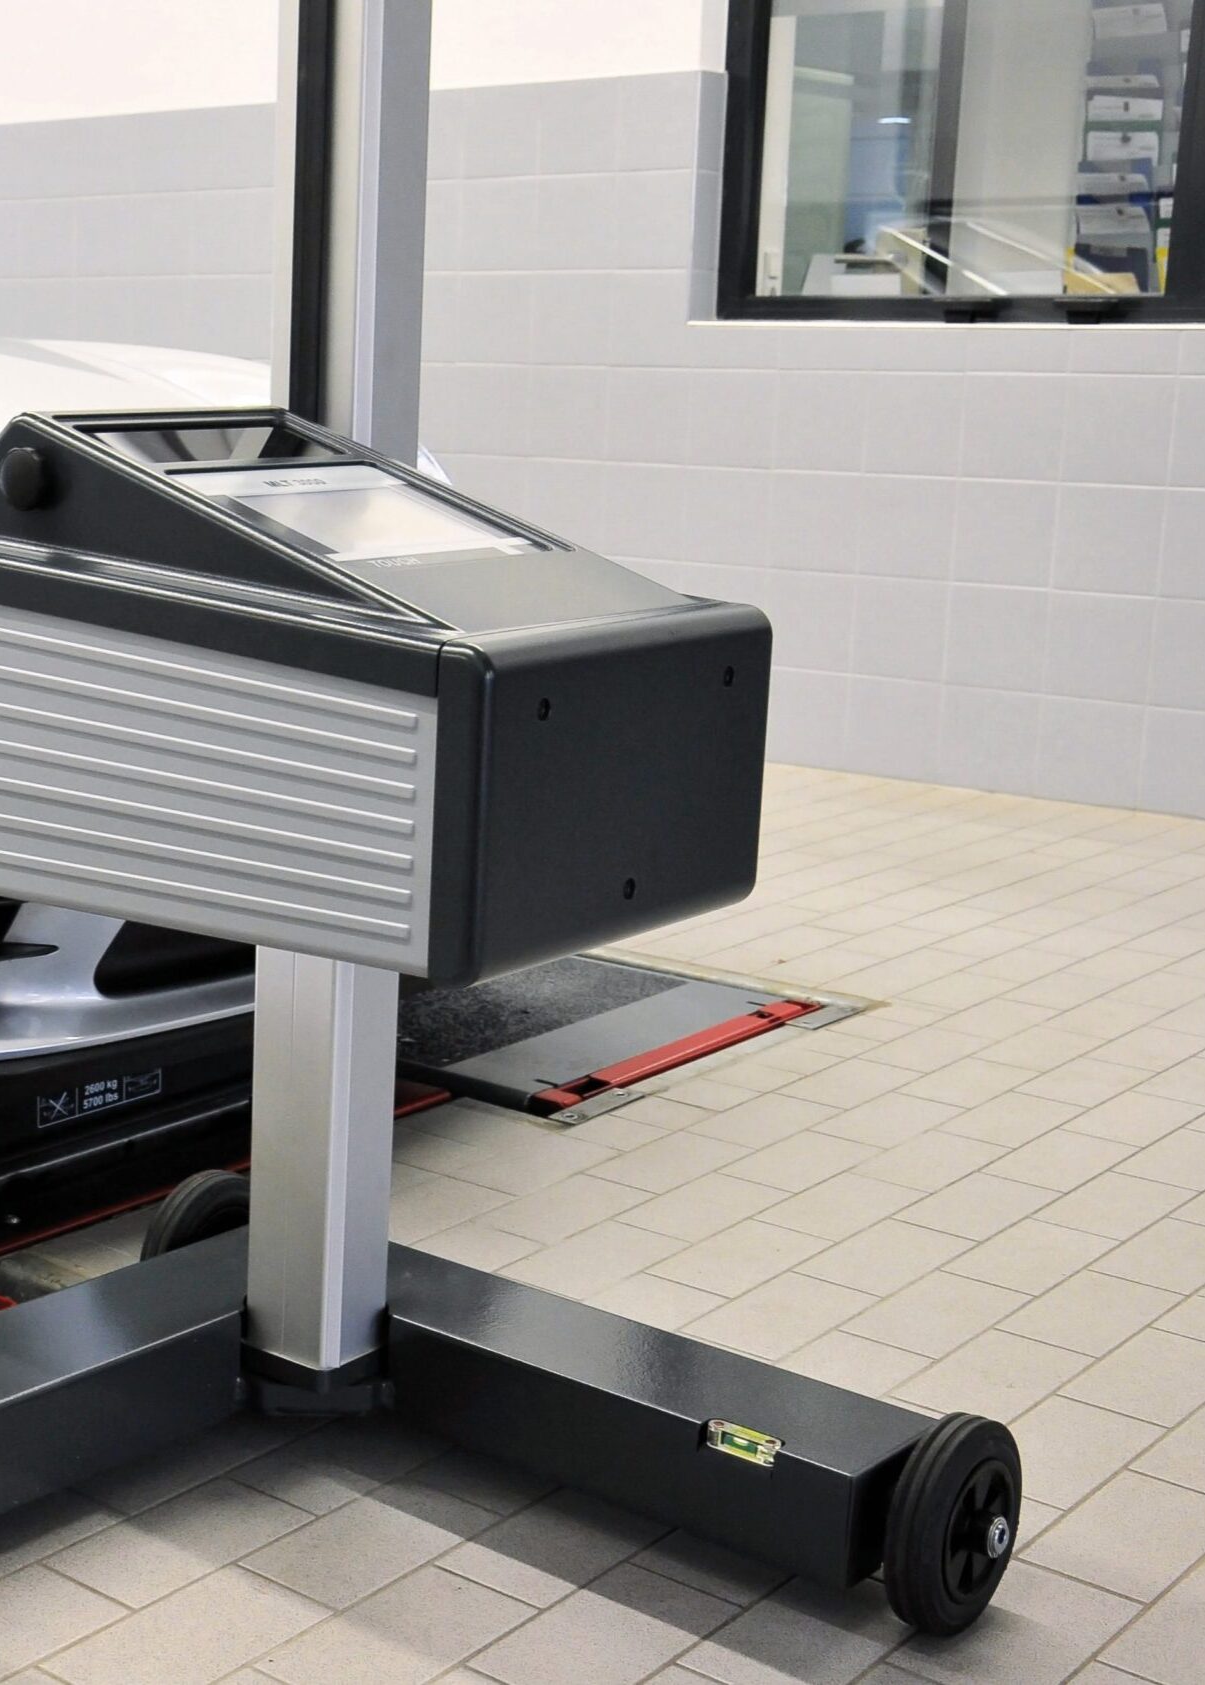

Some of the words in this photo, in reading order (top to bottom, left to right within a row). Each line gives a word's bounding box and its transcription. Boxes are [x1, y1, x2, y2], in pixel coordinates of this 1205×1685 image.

[263, 479, 293, 488] MLT
[366, 557, 422, 569] TOUCH
[84, 1081, 105, 1096] 2600
[106, 1079, 118, 1090] kg
[83, 1095, 103, 1109] 5700
[105, 1092, 119, 1103] lbs
